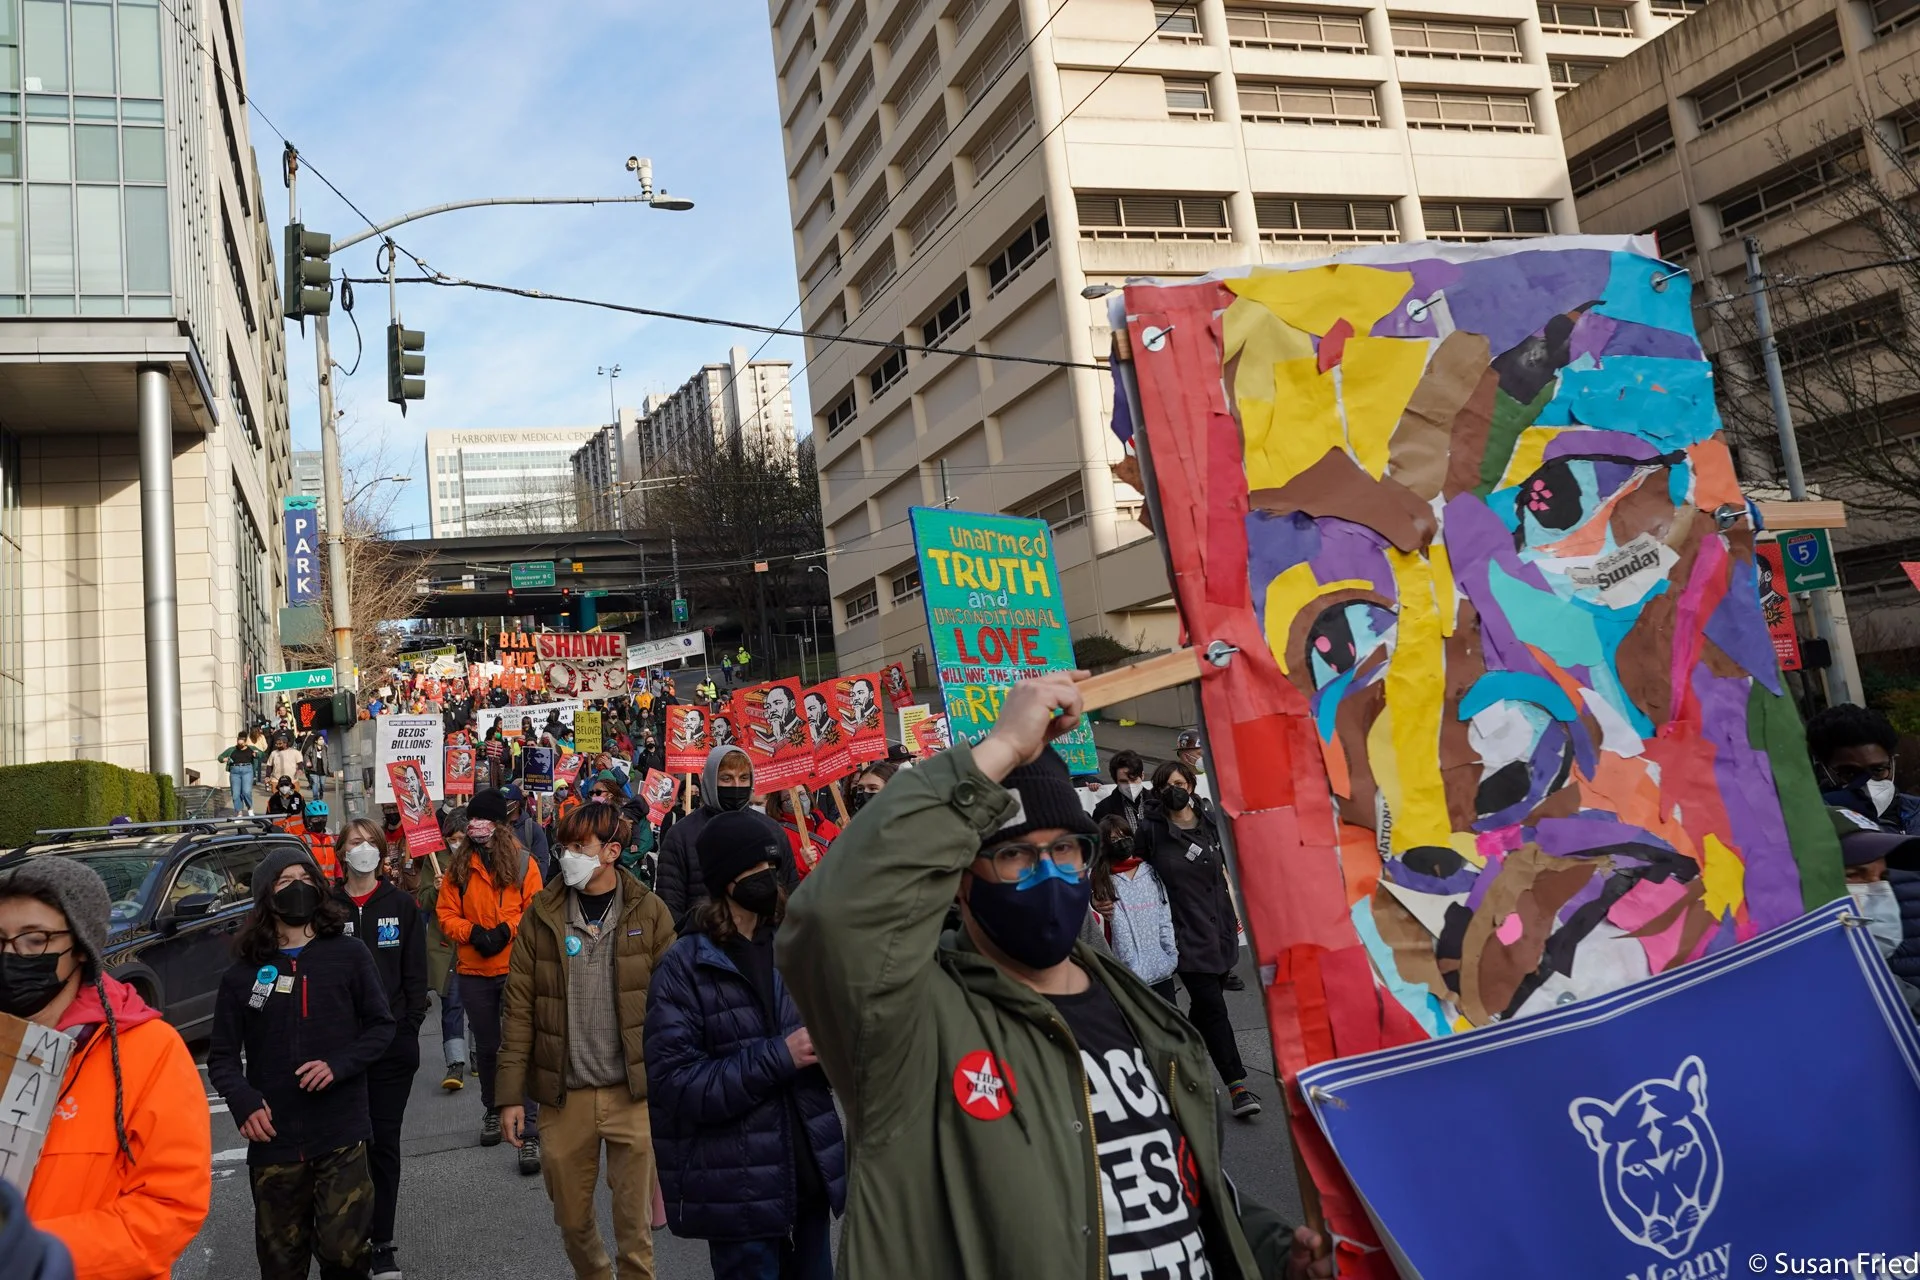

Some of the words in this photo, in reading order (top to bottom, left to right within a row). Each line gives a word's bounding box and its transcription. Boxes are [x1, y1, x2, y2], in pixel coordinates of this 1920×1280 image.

[451, 433, 518, 444] HARBORVIEW
[522, 432, 564, 442] MEDICAL
[948, 525, 1048, 560] unarmed
[294, 518, 311, 594] PARK
[1798, 544, 1810, 561] 5
[927, 548, 1051, 598] TRUTH
[1597, 548, 1660, 592] Sunday
[968, 588, 1008, 608] and
[934, 607, 1062, 629] UNCONDITIONAL
[540, 634, 622, 658] SHAME
[954, 627, 1048, 666] LOVE
[263, 675, 282, 690] 5th
[308, 674, 326, 684] Ave
[544, 662, 625, 698] QFC
[942, 668, 964, 684] WILL
[965, 667, 987, 683] HAVE
[988, 668, 1010, 682] THE
[948, 694, 968, 718] in
[587, 712, 598, 724] THE
[576, 726, 602, 736] BELOVED
[391, 740, 434, 750] BILLIONS:
[378, 917, 400, 926] ALPHA
[976, 1072, 998, 1086] THE
[966, 1082, 1003, 1099] CLASH
